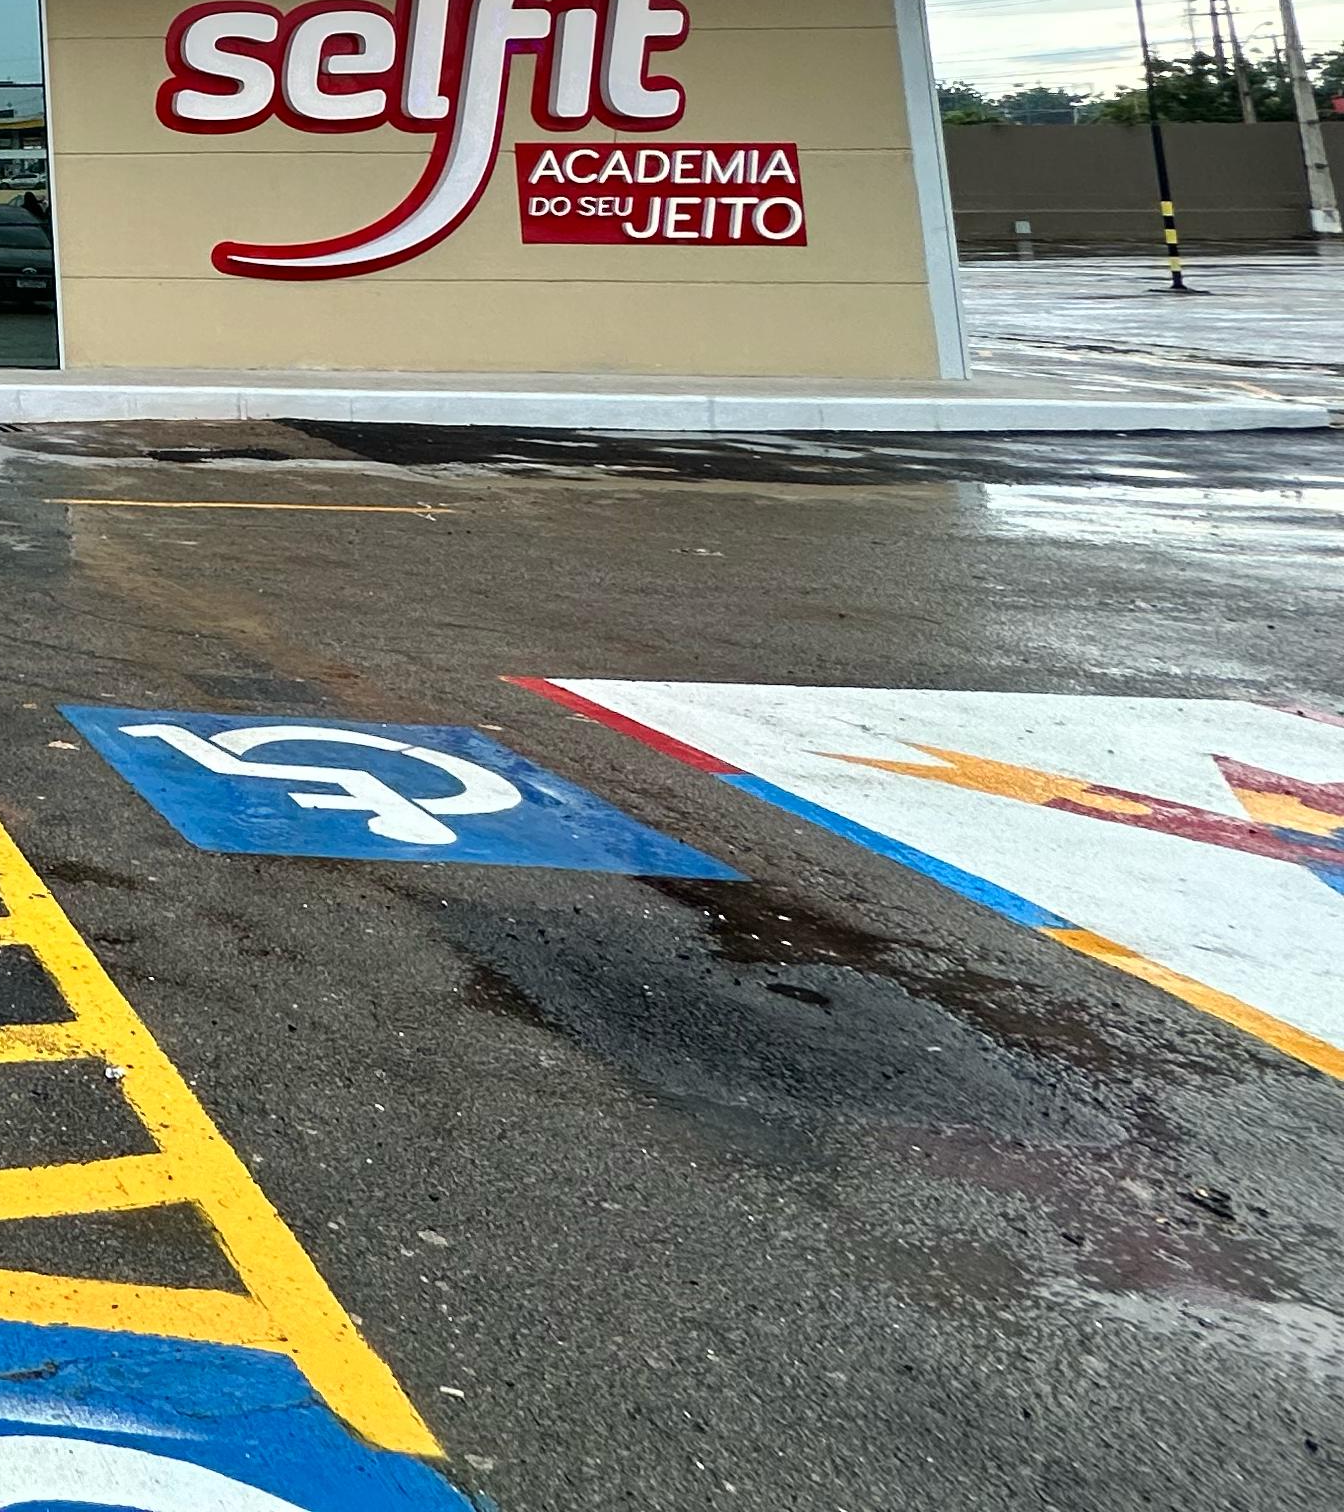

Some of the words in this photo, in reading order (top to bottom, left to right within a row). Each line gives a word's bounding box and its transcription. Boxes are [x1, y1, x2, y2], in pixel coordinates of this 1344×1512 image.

[528, 149, 796, 184] ACADEMIA
[529, 196, 571, 216] DO
[576, 196, 634, 217] SEU
[622, 196, 803, 240] JEITO
